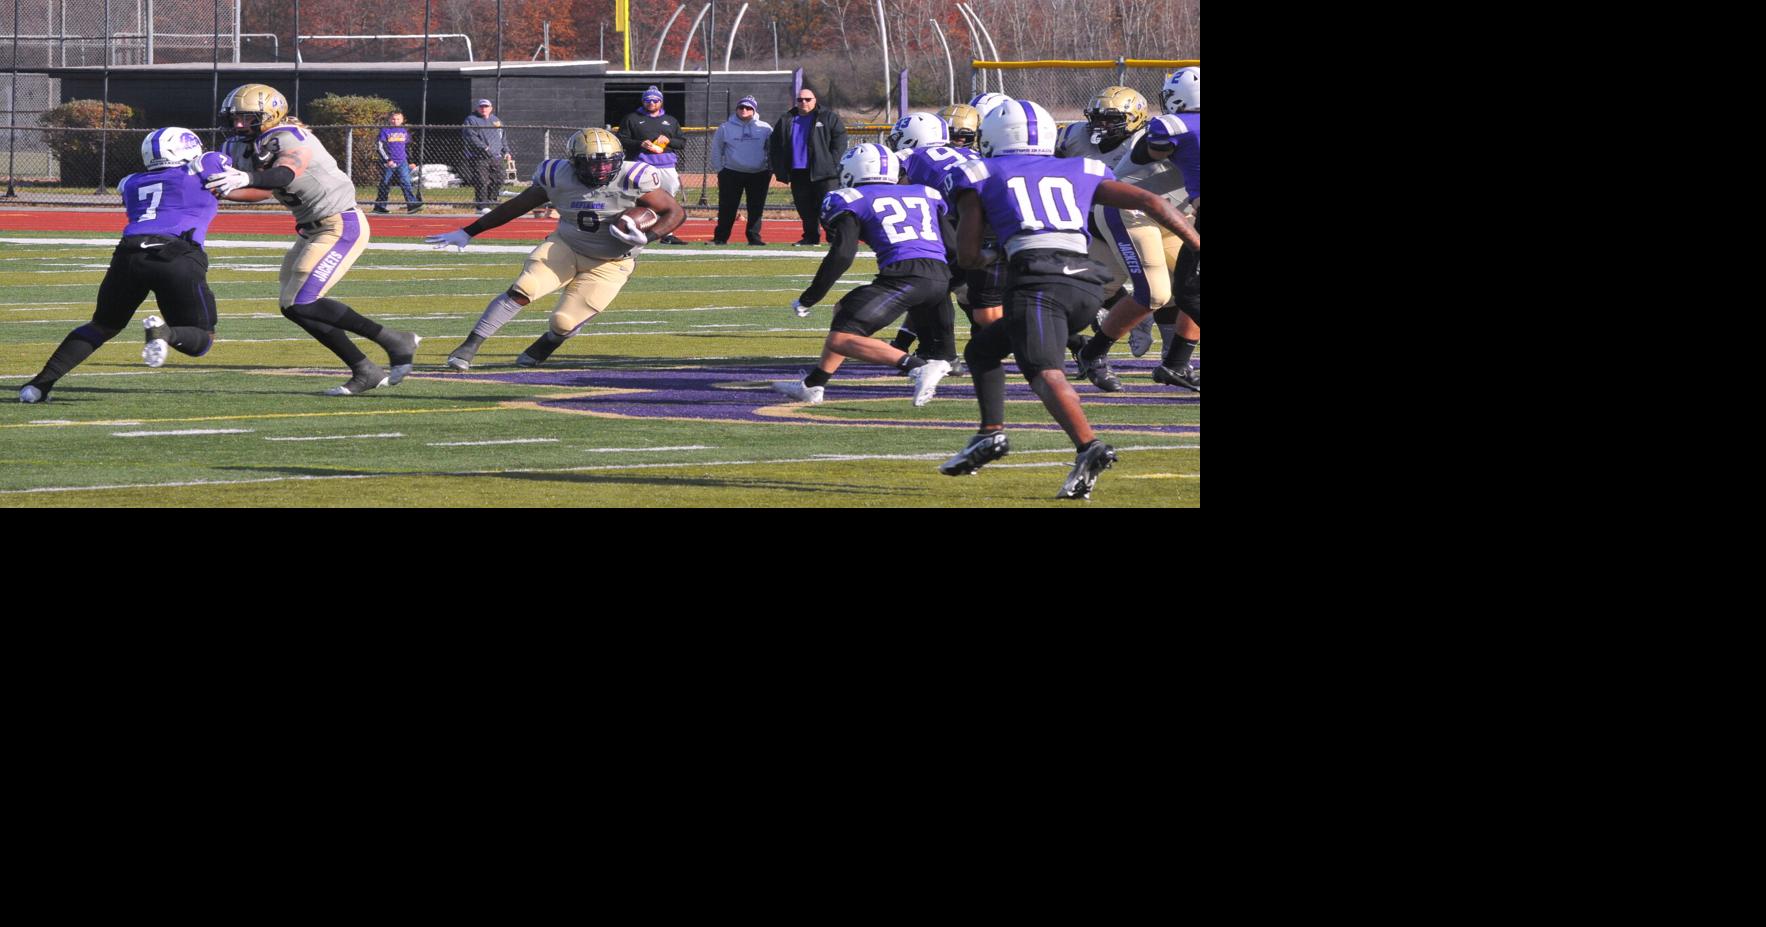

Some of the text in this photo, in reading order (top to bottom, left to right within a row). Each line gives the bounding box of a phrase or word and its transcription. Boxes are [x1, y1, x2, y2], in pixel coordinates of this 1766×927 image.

[138, 182, 163, 223] 7
[1007, 176, 1084, 231] 10
[577, 210, 600, 233] 0
[872, 197, 939, 245] 27
[312, 250, 343, 282] JACKETS
[1118, 242, 1142, 274] JACKETS
